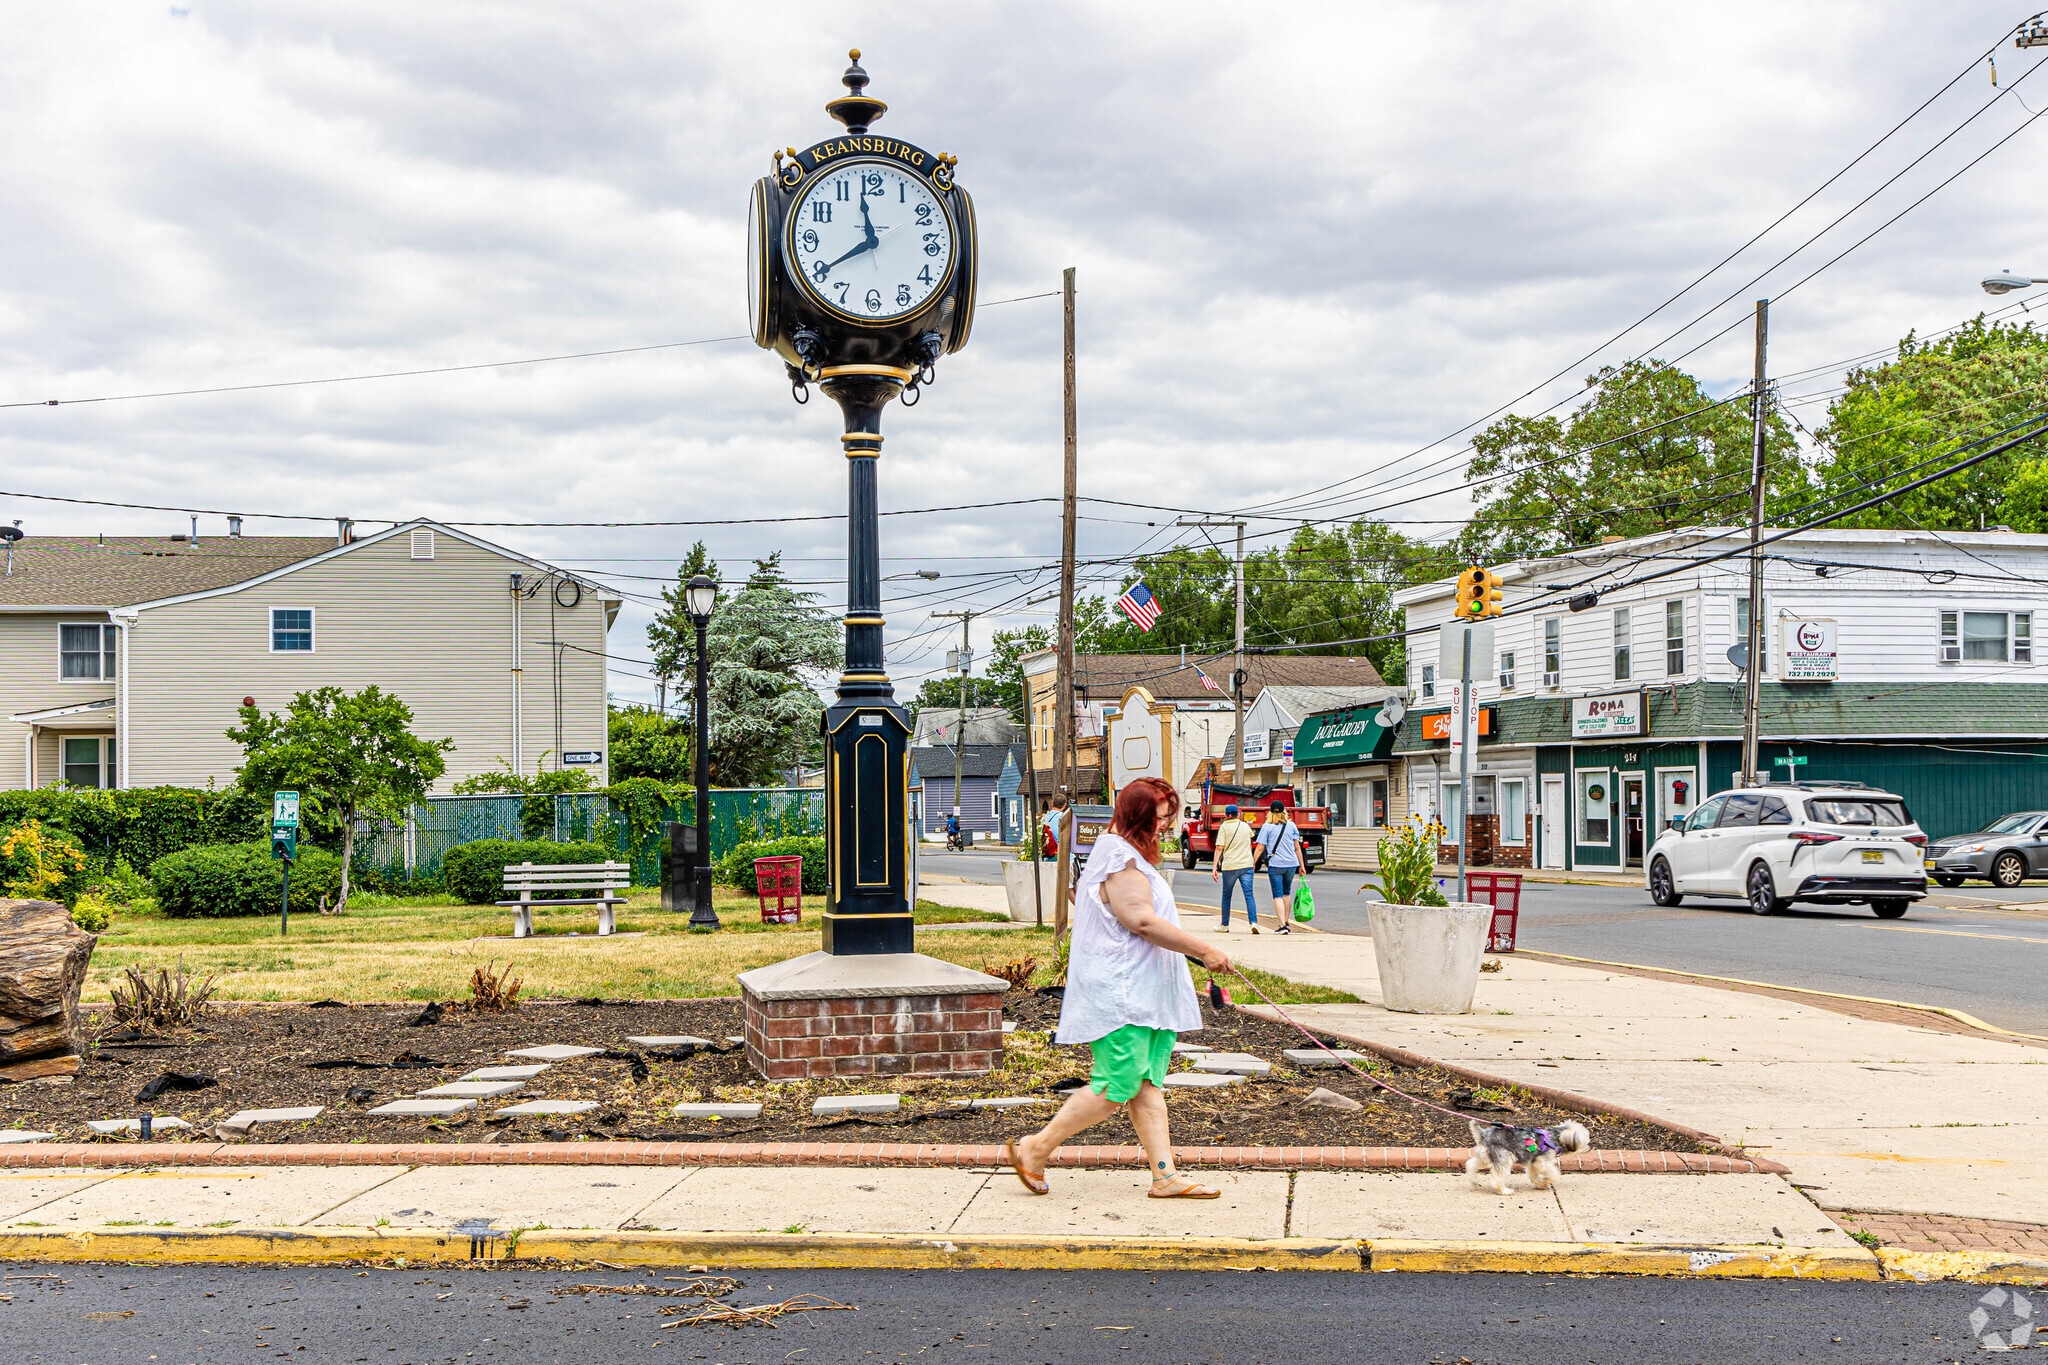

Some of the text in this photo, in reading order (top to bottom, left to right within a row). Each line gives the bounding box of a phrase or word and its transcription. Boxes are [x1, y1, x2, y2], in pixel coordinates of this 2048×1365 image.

[811, 137, 925, 166] KEANSBURG
[836, 180, 850, 201] 11
[861, 174, 885, 196] 12
[899, 182, 905, 203] 1
[812, 201, 832, 223] 10
[914, 203, 933, 226] 2
[801, 229, 820, 253] 9
[922, 232, 941, 257] 3
[812, 260, 828, 283] 8
[916, 264, 933, 286] 4
[833, 281, 850, 304] 7
[864, 289, 882, 313] 6
[896, 284, 912, 306] 5
[1588, 700, 1624, 716] ROMA
[1310, 720, 1369, 744] JADE GARDEN
